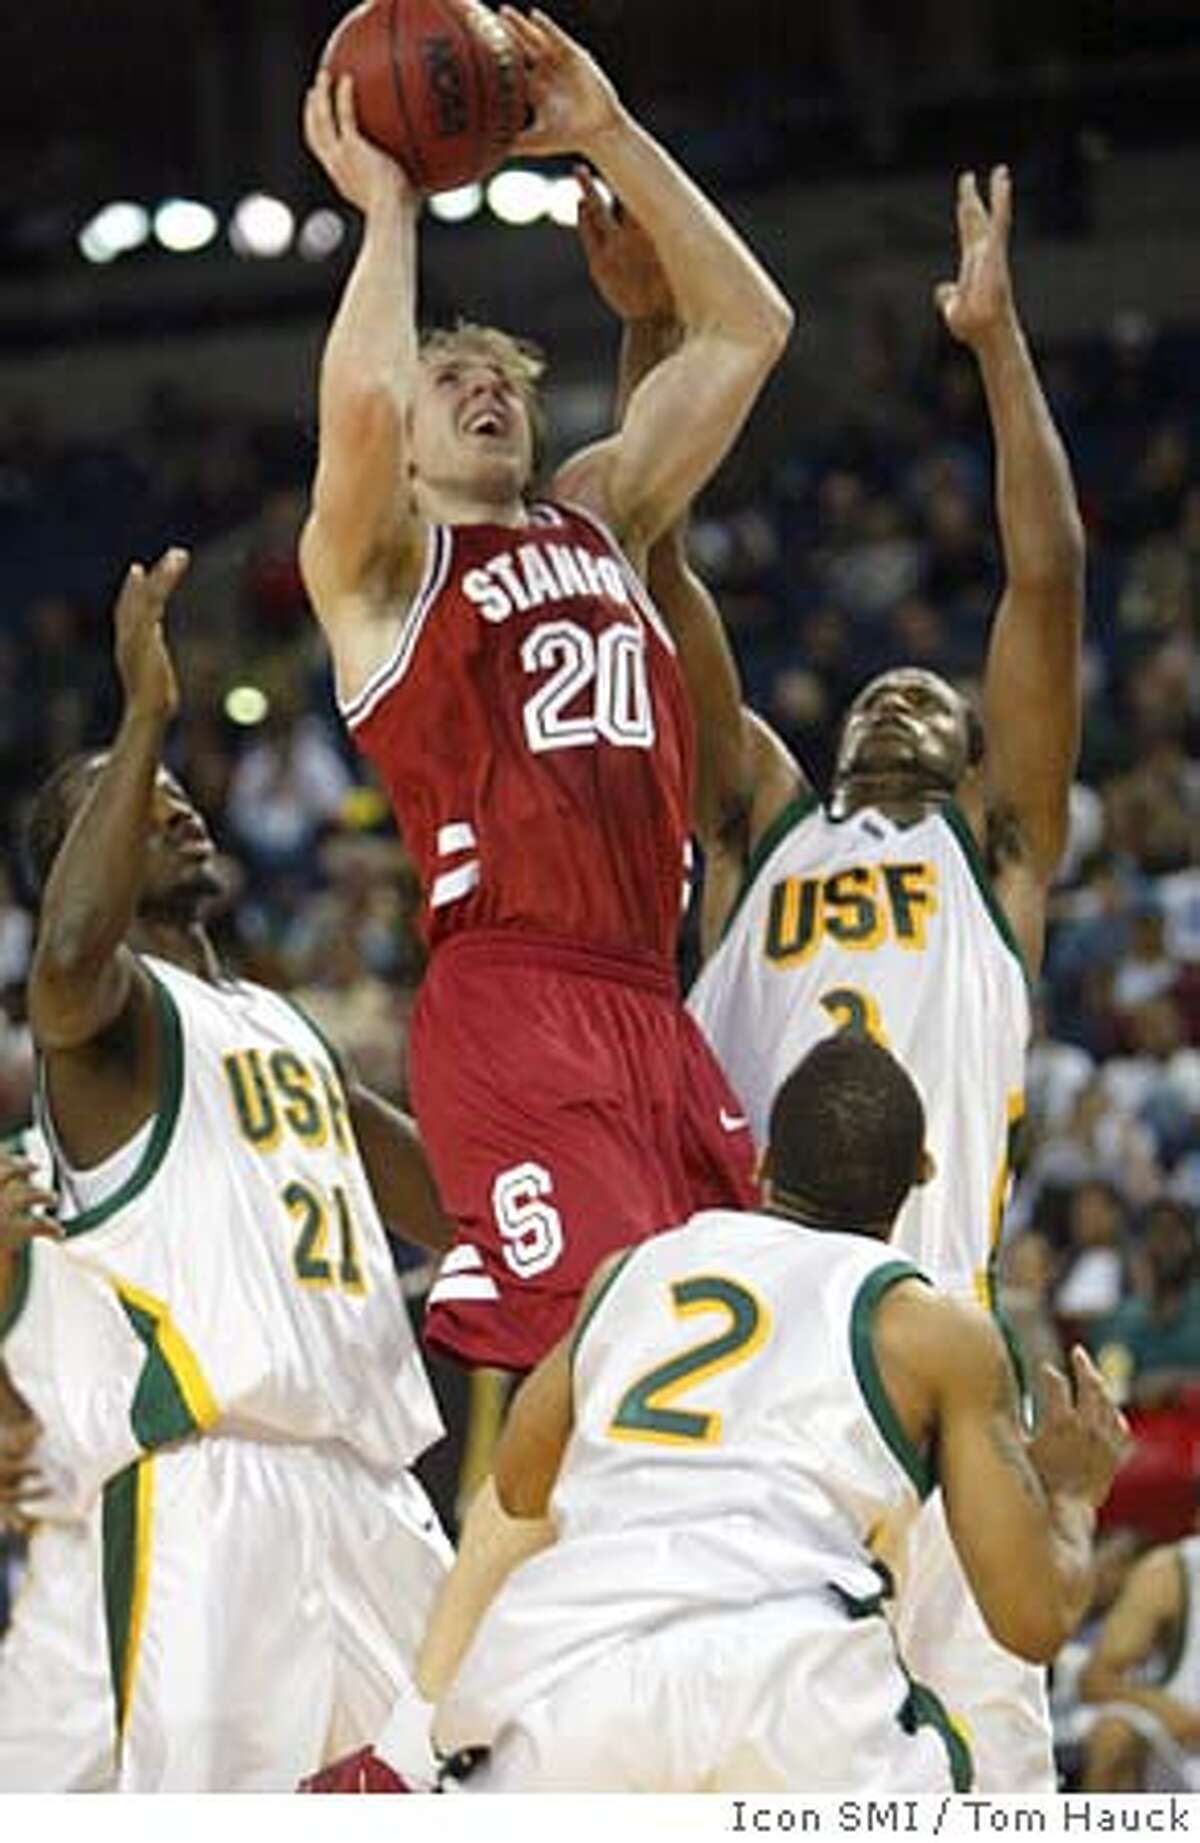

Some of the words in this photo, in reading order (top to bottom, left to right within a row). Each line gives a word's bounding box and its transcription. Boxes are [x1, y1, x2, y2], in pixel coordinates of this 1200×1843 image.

[520, 620, 655, 753] 20
[764, 861, 937, 972] USF
[282, 1181, 367, 1297] 21
[492, 1161, 563, 1279] S
[608, 1272, 774, 1446] 2
